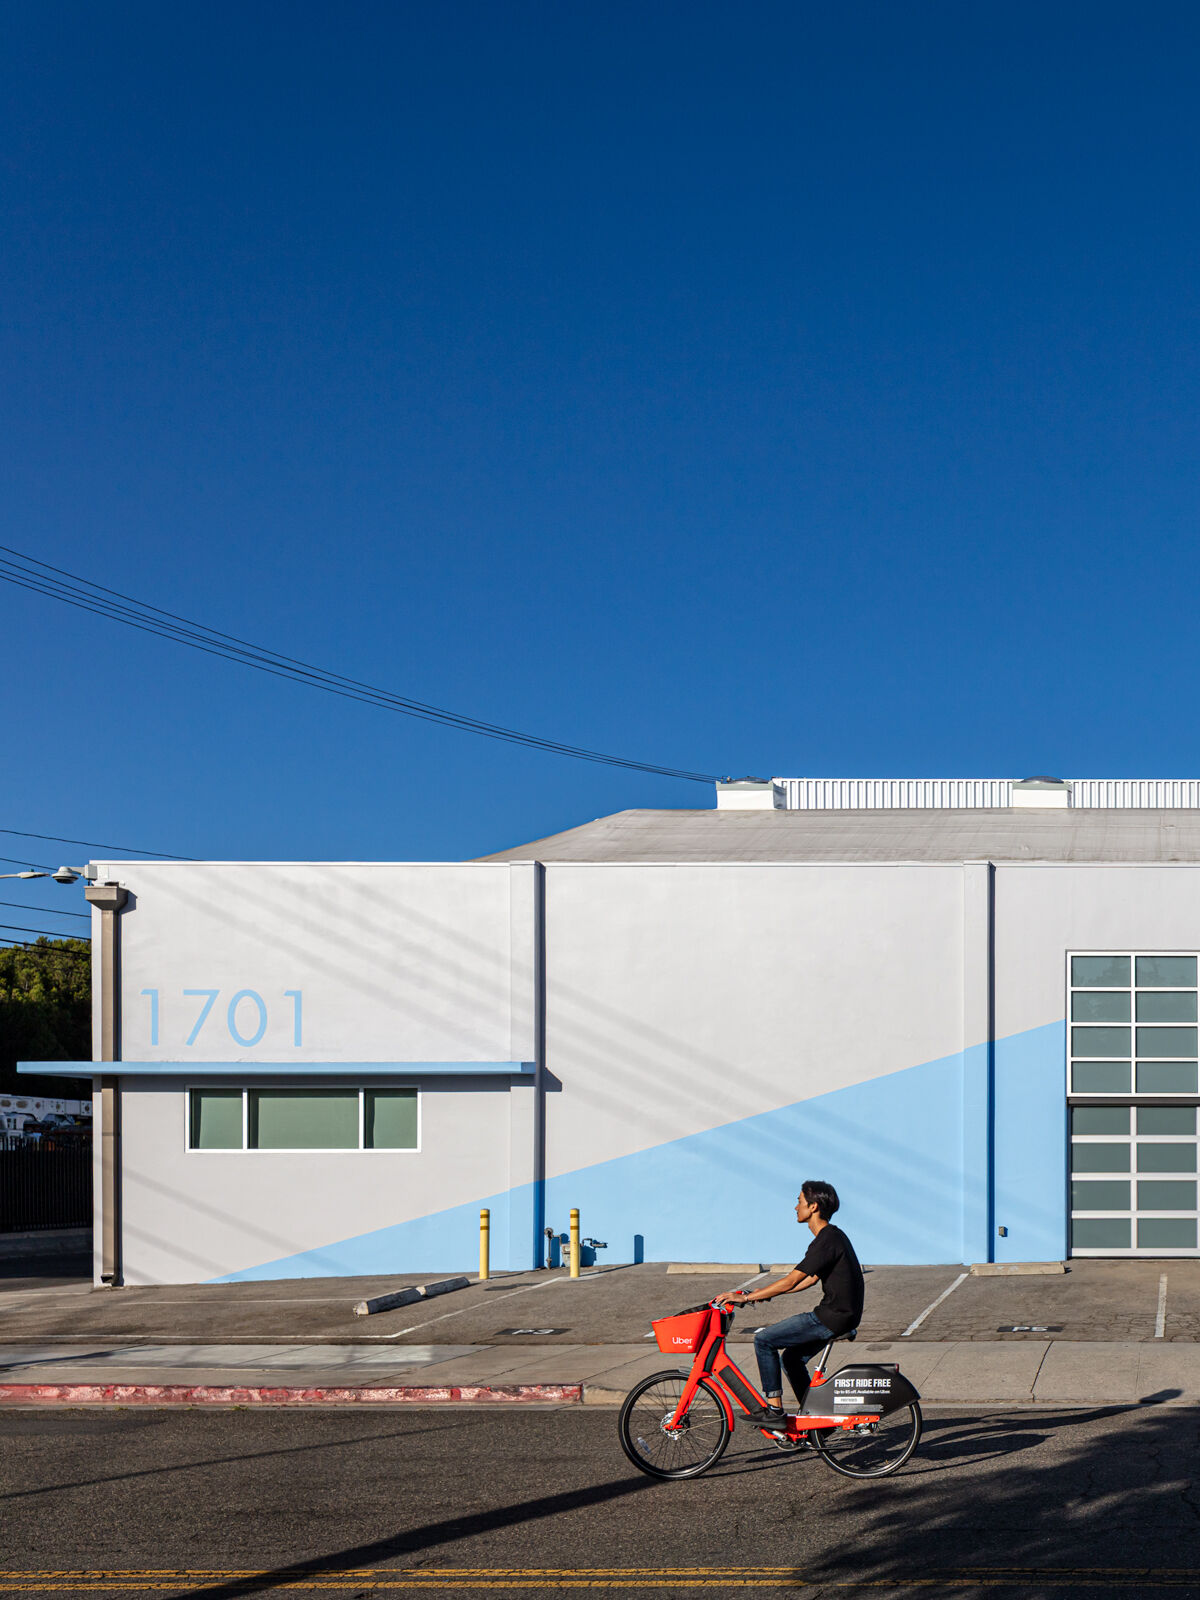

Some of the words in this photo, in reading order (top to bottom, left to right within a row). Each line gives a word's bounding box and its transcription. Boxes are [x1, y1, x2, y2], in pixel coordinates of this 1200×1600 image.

[140, 988, 303, 1048] 1701
[672, 1336, 693, 1345] Uber
[834, 1378, 855, 1388] FIRST
[855, 1378, 873, 1388] RIDE
[873, 1378, 892, 1388] FREE
